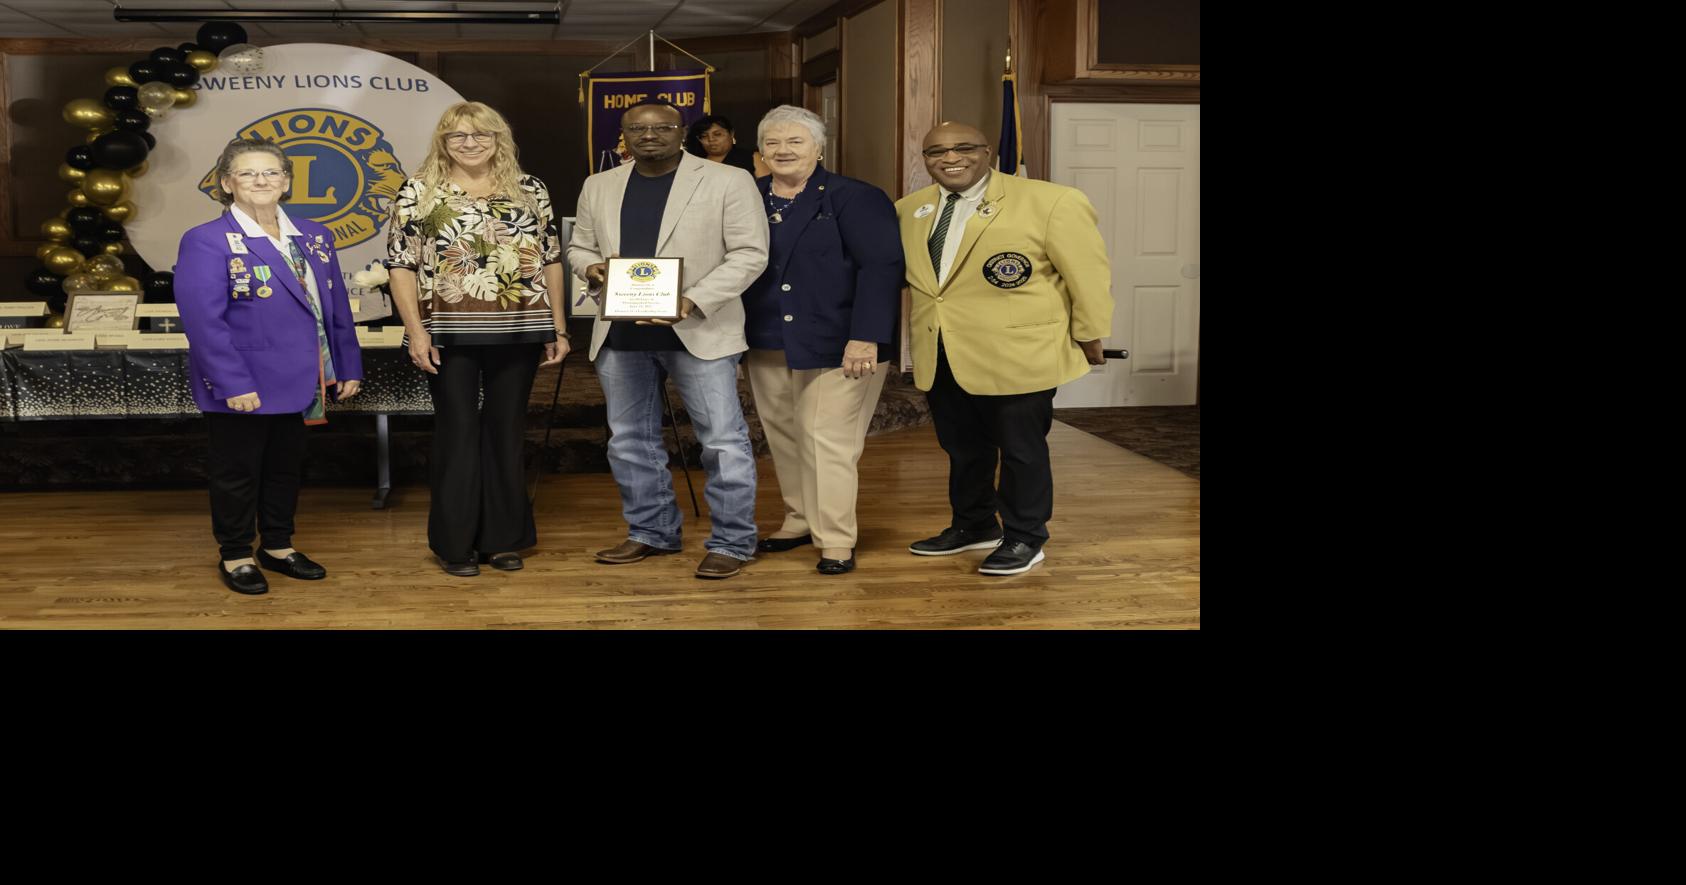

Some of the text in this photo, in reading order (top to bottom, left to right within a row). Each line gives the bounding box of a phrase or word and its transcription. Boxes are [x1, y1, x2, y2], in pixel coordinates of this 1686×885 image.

[295, 75, 362, 88] LIONS
[370, 76, 429, 92] CLUB
[286, 155, 337, 204] L
[640, 267, 649, 276] L
